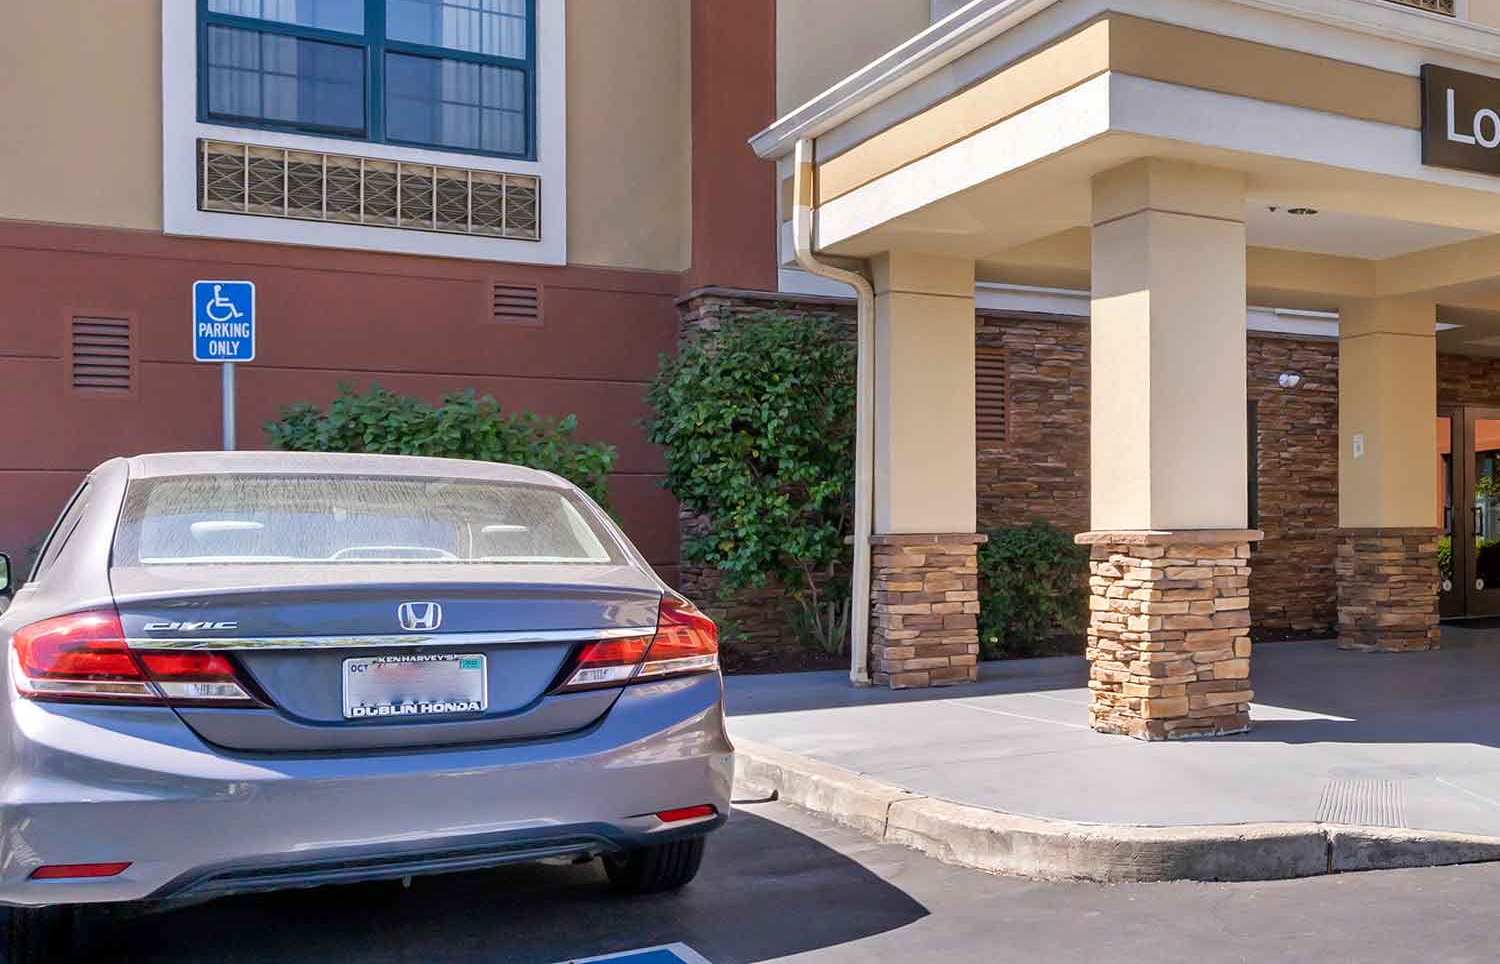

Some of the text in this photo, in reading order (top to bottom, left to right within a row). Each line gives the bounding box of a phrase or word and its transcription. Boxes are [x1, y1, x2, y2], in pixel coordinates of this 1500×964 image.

[199, 322, 250, 338] PARKING
[209, 340, 240, 356] ONLY
[143, 621, 238, 631] CIVIC
[351, 664, 368, 673] OCT
[352, 700, 480, 717] DUBLIN HONDA
